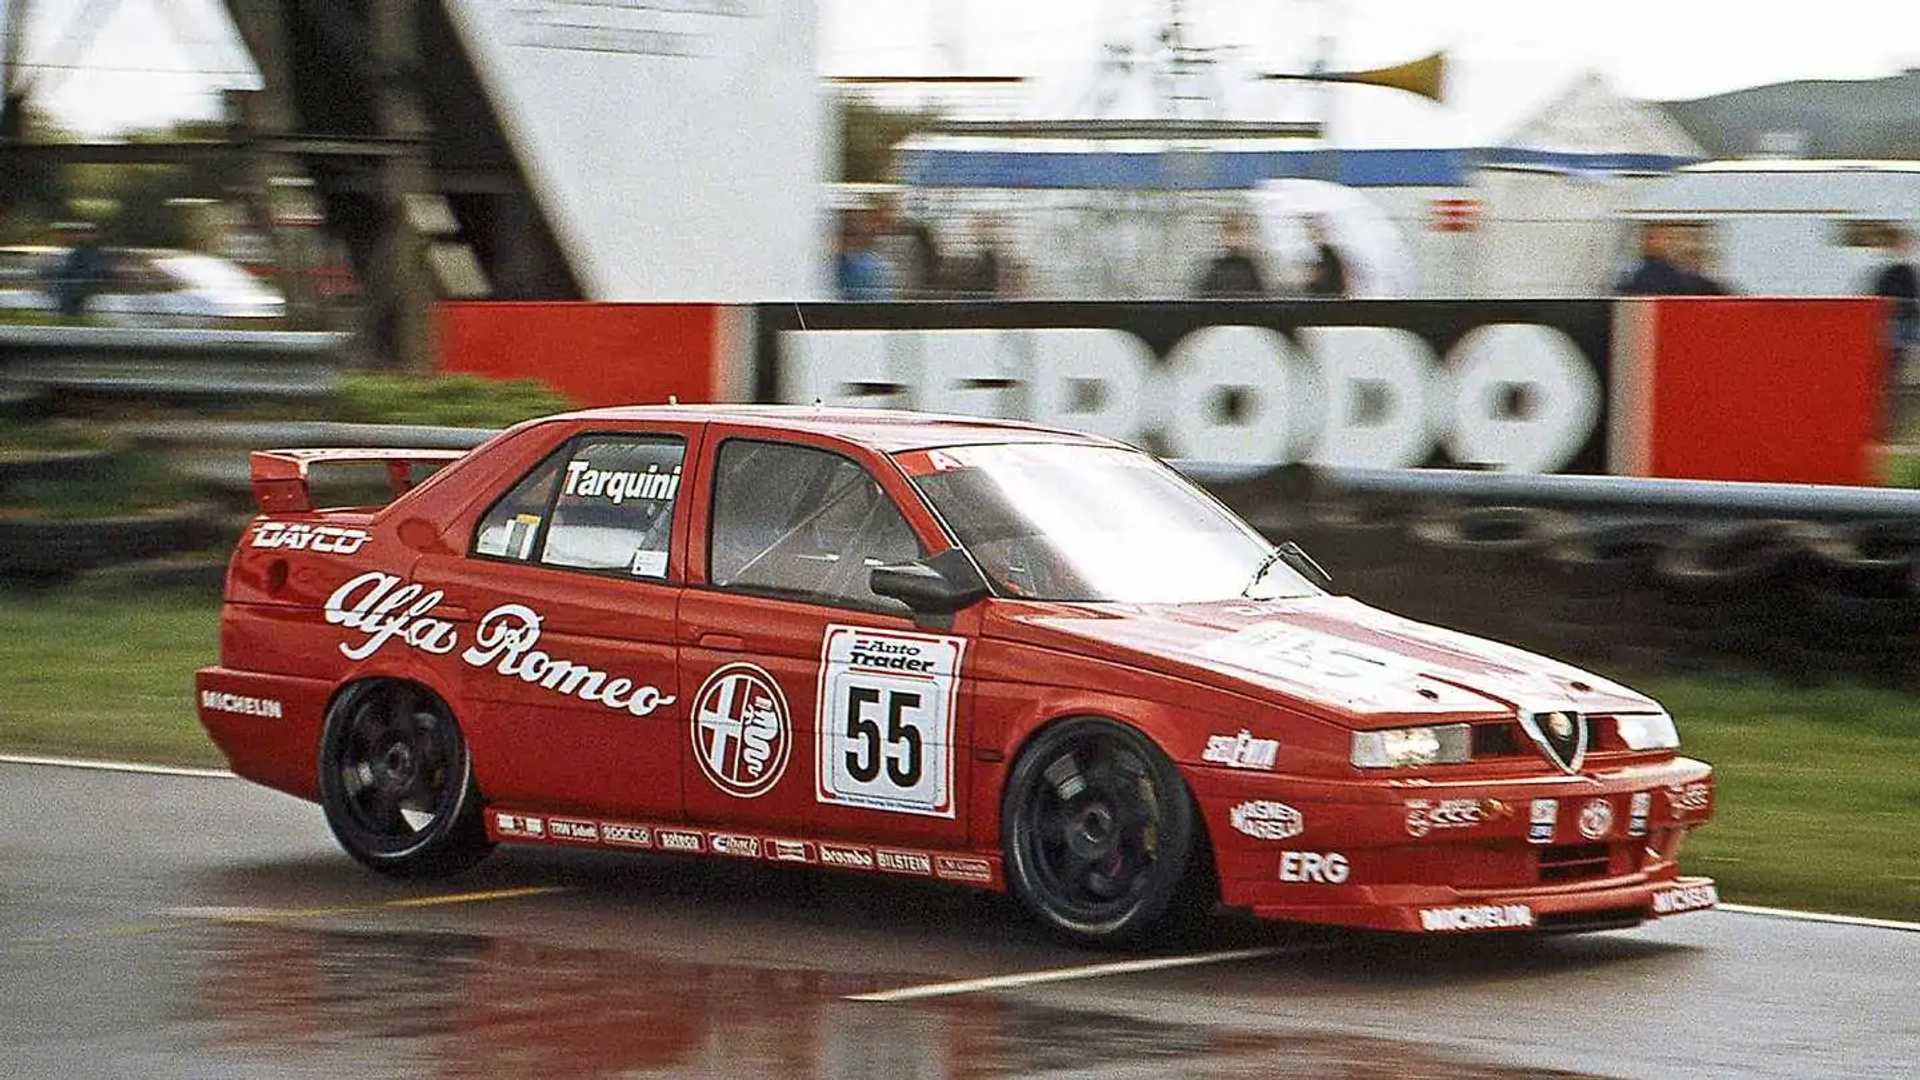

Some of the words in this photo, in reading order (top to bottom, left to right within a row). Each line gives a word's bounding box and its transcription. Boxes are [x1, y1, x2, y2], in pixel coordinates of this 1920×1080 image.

[566, 460, 681, 506] Tarquini
[250, 522, 372, 554] DAYCO
[323, 571, 457, 661] Alfa
[461, 603, 676, 717] Romeo
[868, 640, 921, 655] Auto
[850, 652, 935, 672] Trader
[201, 690, 282, 719] MICHELIN
[845, 686, 923, 788] 55
[877, 853, 930, 871] BILSTEIN
[1279, 851, 1349, 883] ERG
